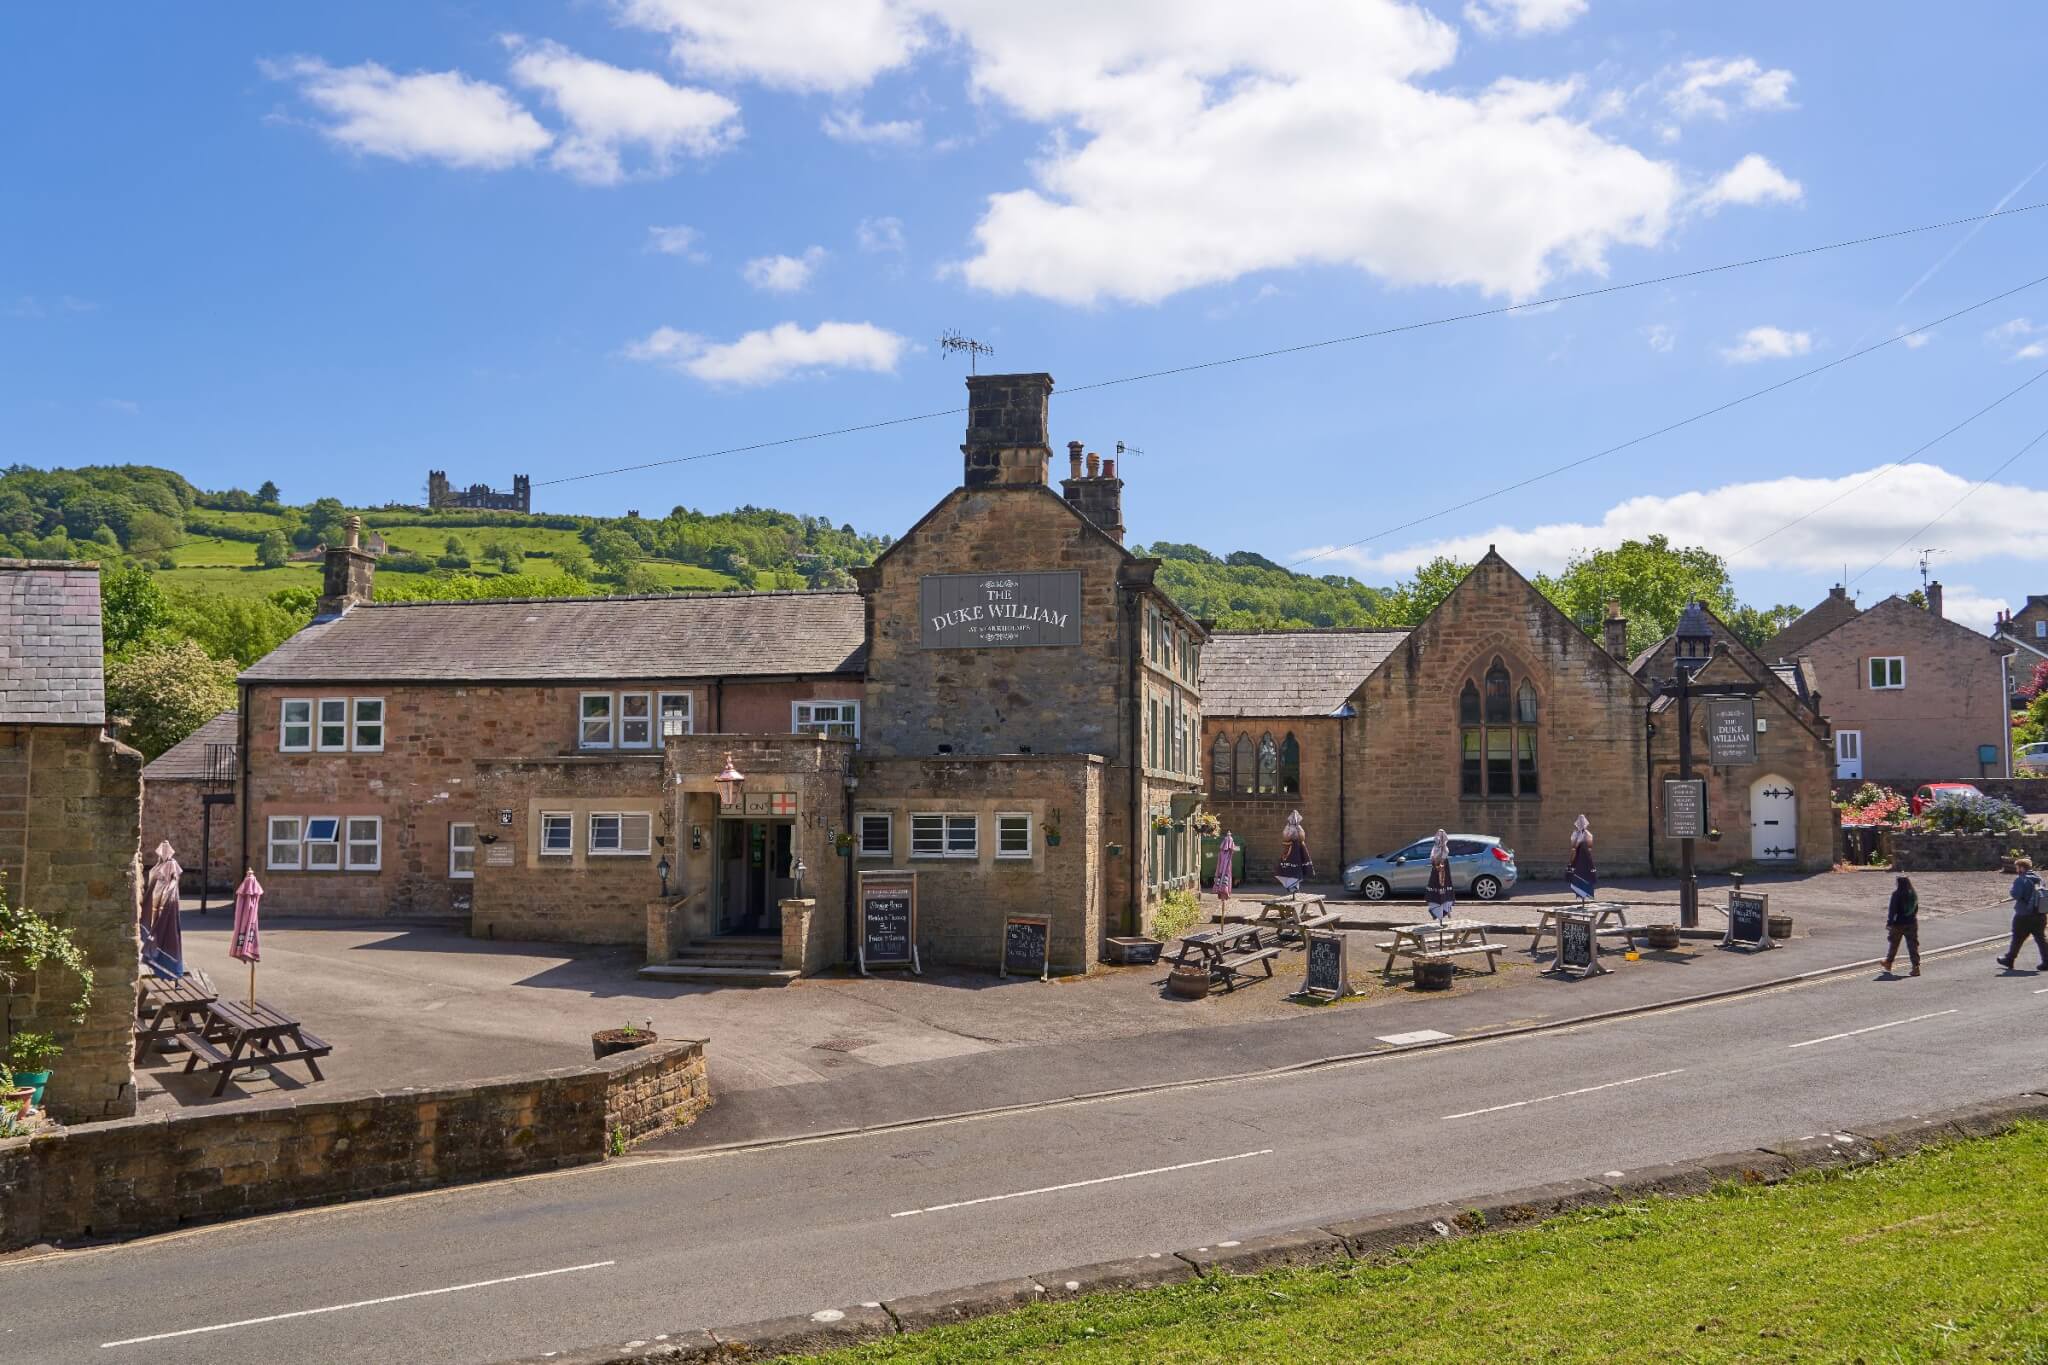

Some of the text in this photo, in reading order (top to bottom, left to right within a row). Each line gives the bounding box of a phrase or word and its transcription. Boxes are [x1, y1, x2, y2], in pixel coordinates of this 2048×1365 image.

[986, 590, 1012, 601] THE
[932, 603, 1068, 631] DUKE WILLIAM
[1718, 725, 1744, 734] DUKE
[1712, 734, 1750, 743] WILLIAM
